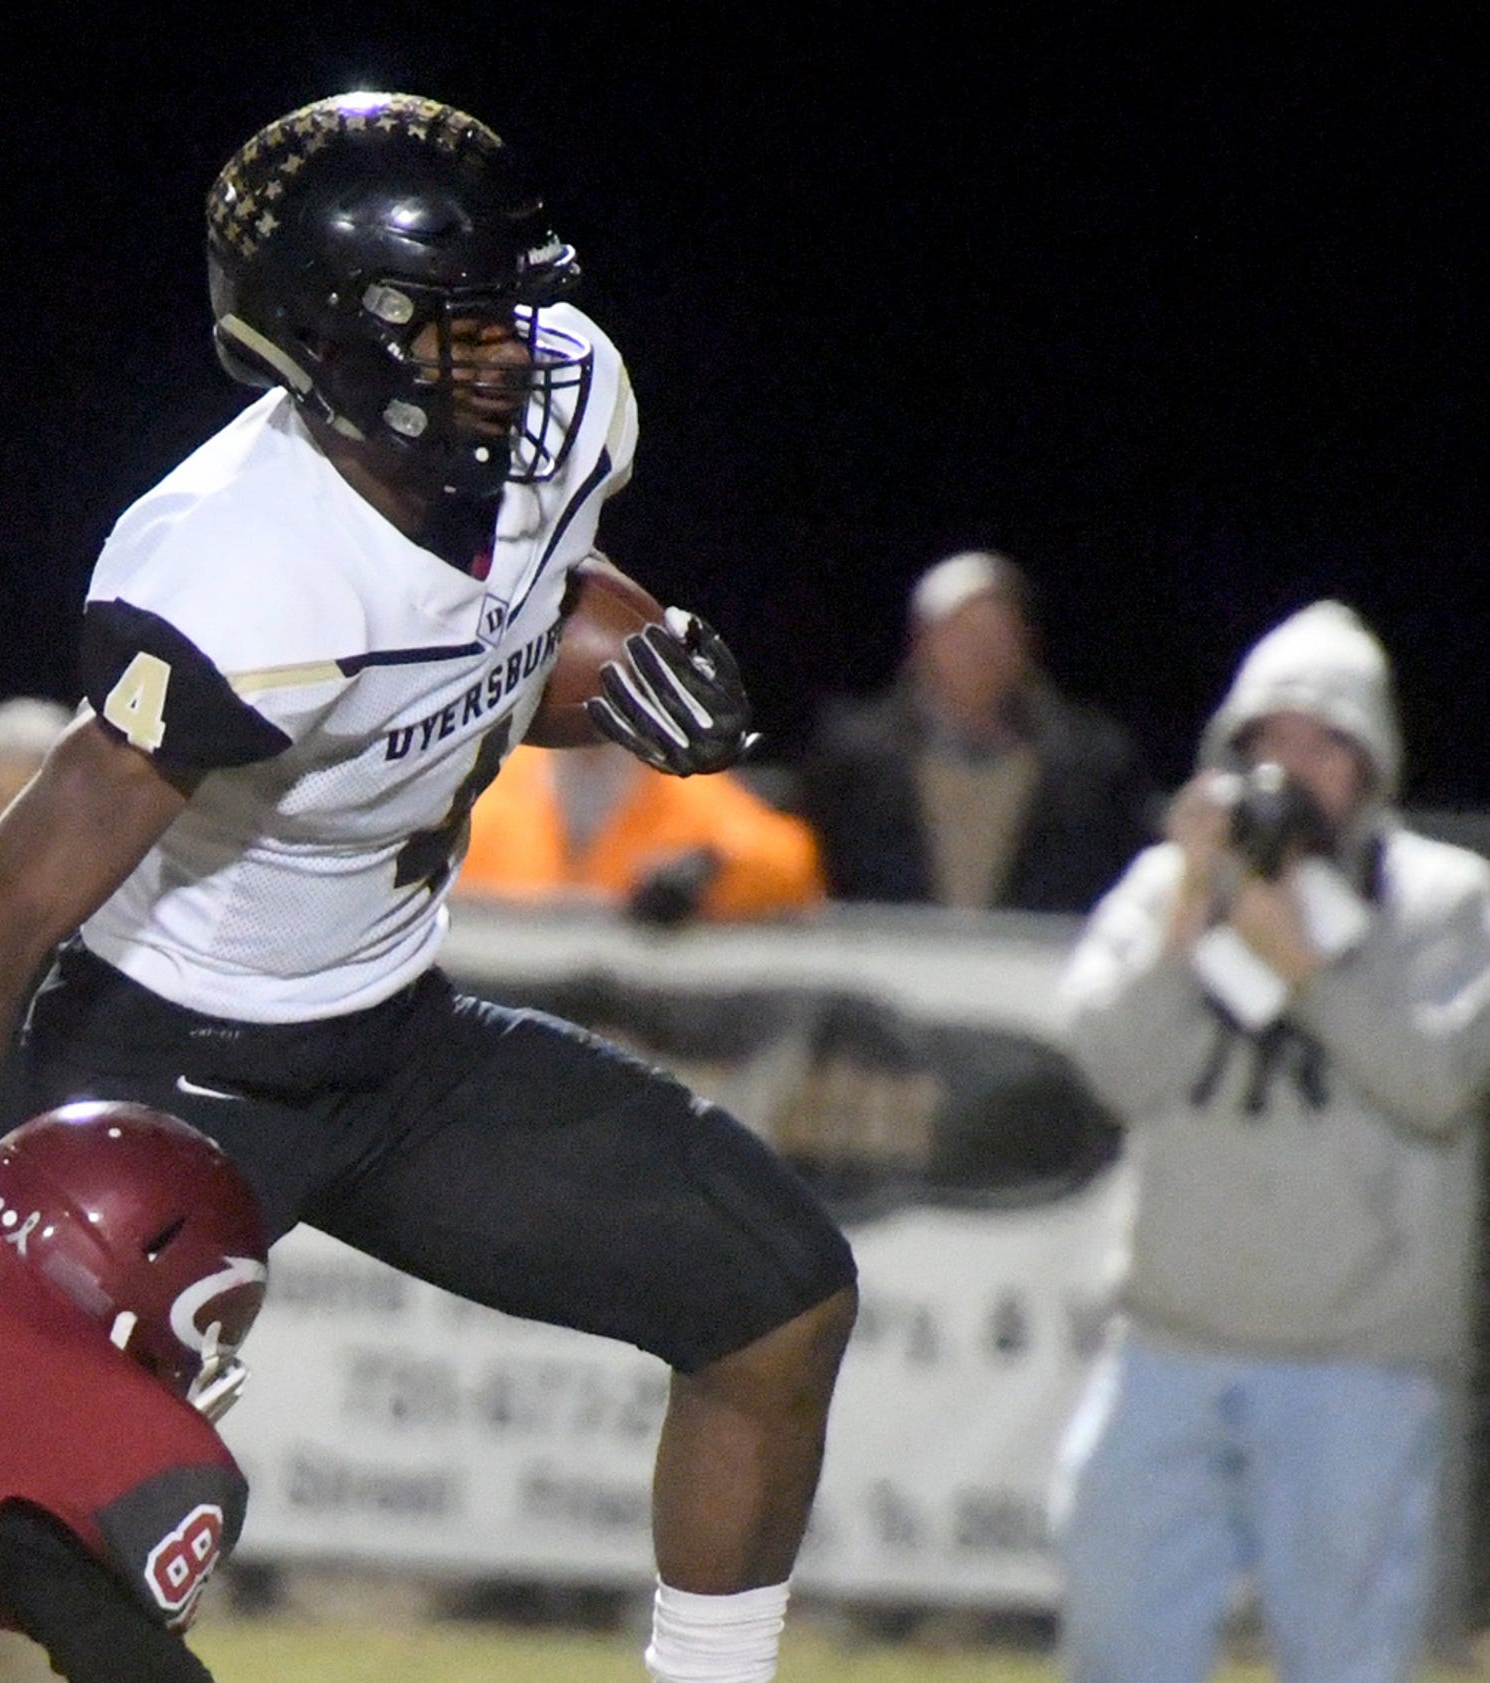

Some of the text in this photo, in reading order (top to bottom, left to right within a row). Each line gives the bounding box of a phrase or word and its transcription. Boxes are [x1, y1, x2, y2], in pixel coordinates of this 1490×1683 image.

[103, 651, 172, 754] 4
[385, 622, 562, 761] DYERSBUR
[144, 1504, 224, 1630] 8
